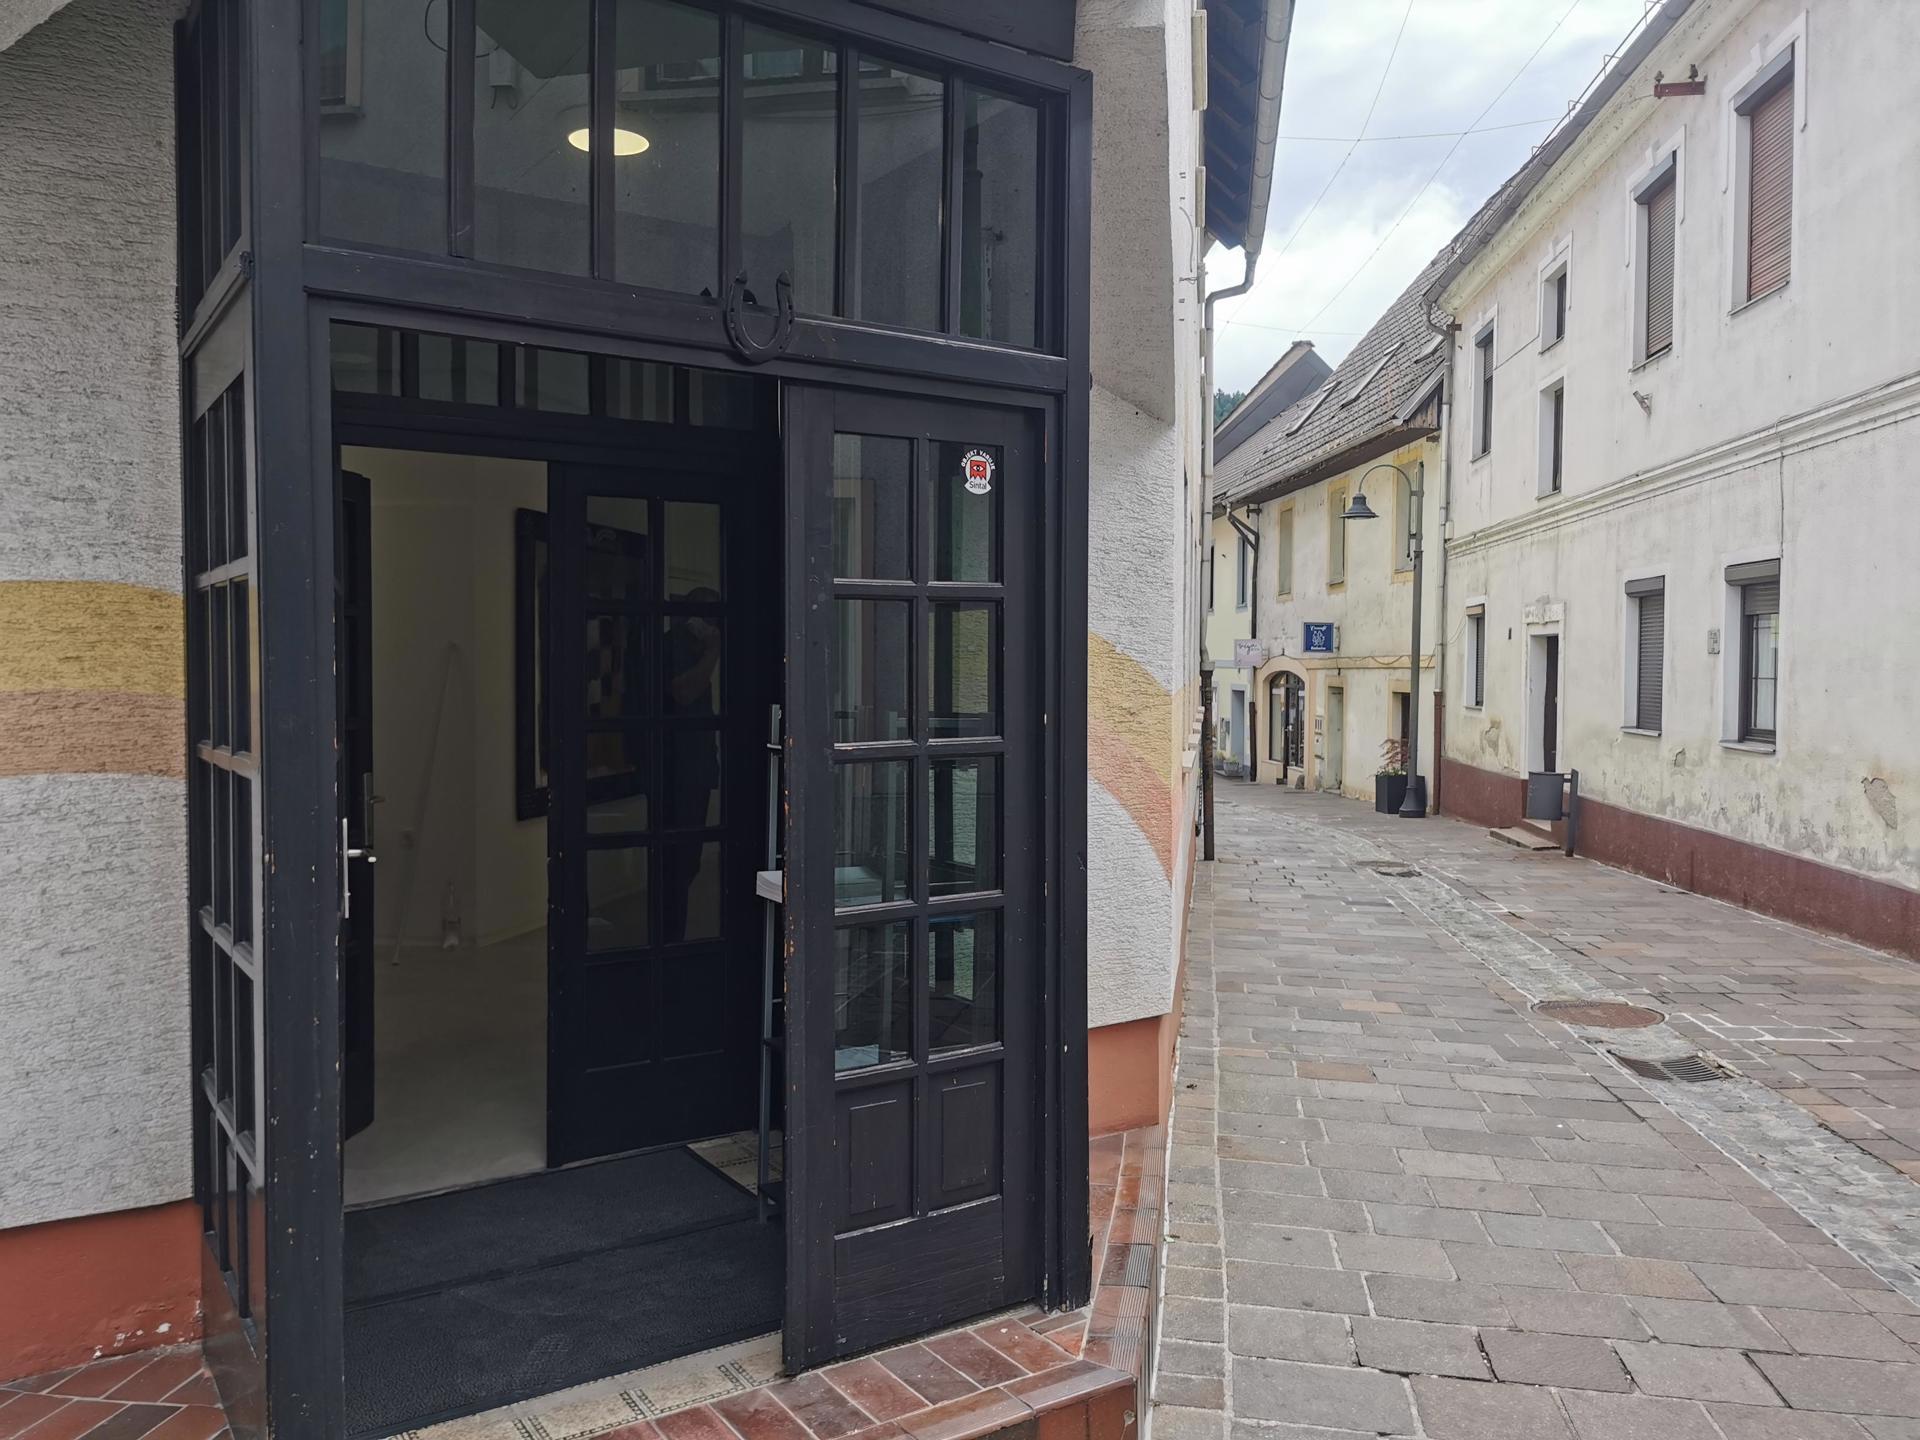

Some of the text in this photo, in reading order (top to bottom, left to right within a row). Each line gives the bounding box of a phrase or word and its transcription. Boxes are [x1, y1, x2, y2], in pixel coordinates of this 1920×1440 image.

[961, 449, 996, 470] OBJEKT VARUJE
[969, 481, 987, 490] Sintal
